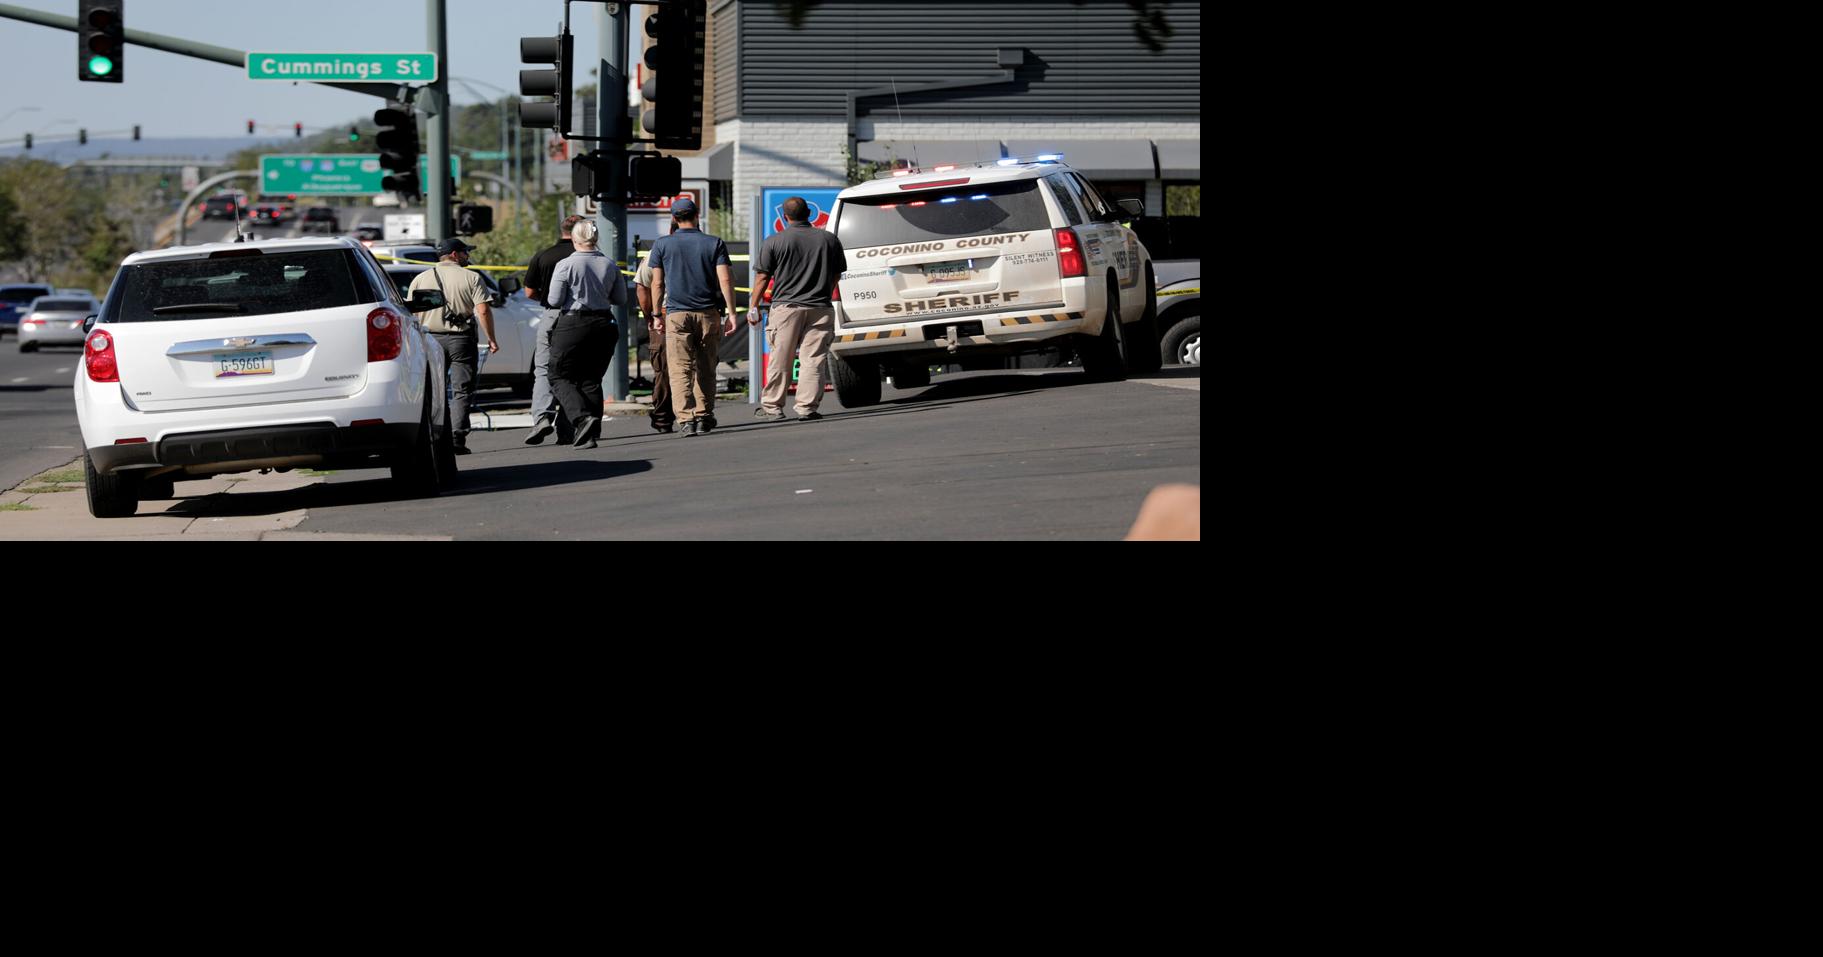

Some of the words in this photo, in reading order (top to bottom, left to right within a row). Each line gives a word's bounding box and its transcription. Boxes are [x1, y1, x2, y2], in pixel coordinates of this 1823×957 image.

[261, 58, 383, 79] Cummings
[396, 59, 422, 75] St
[855, 242, 945, 259] COCONINO
[956, 233, 1031, 249] COUNTY
[853, 290, 877, 301] P950
[883, 291, 1020, 314] SHERIFF
